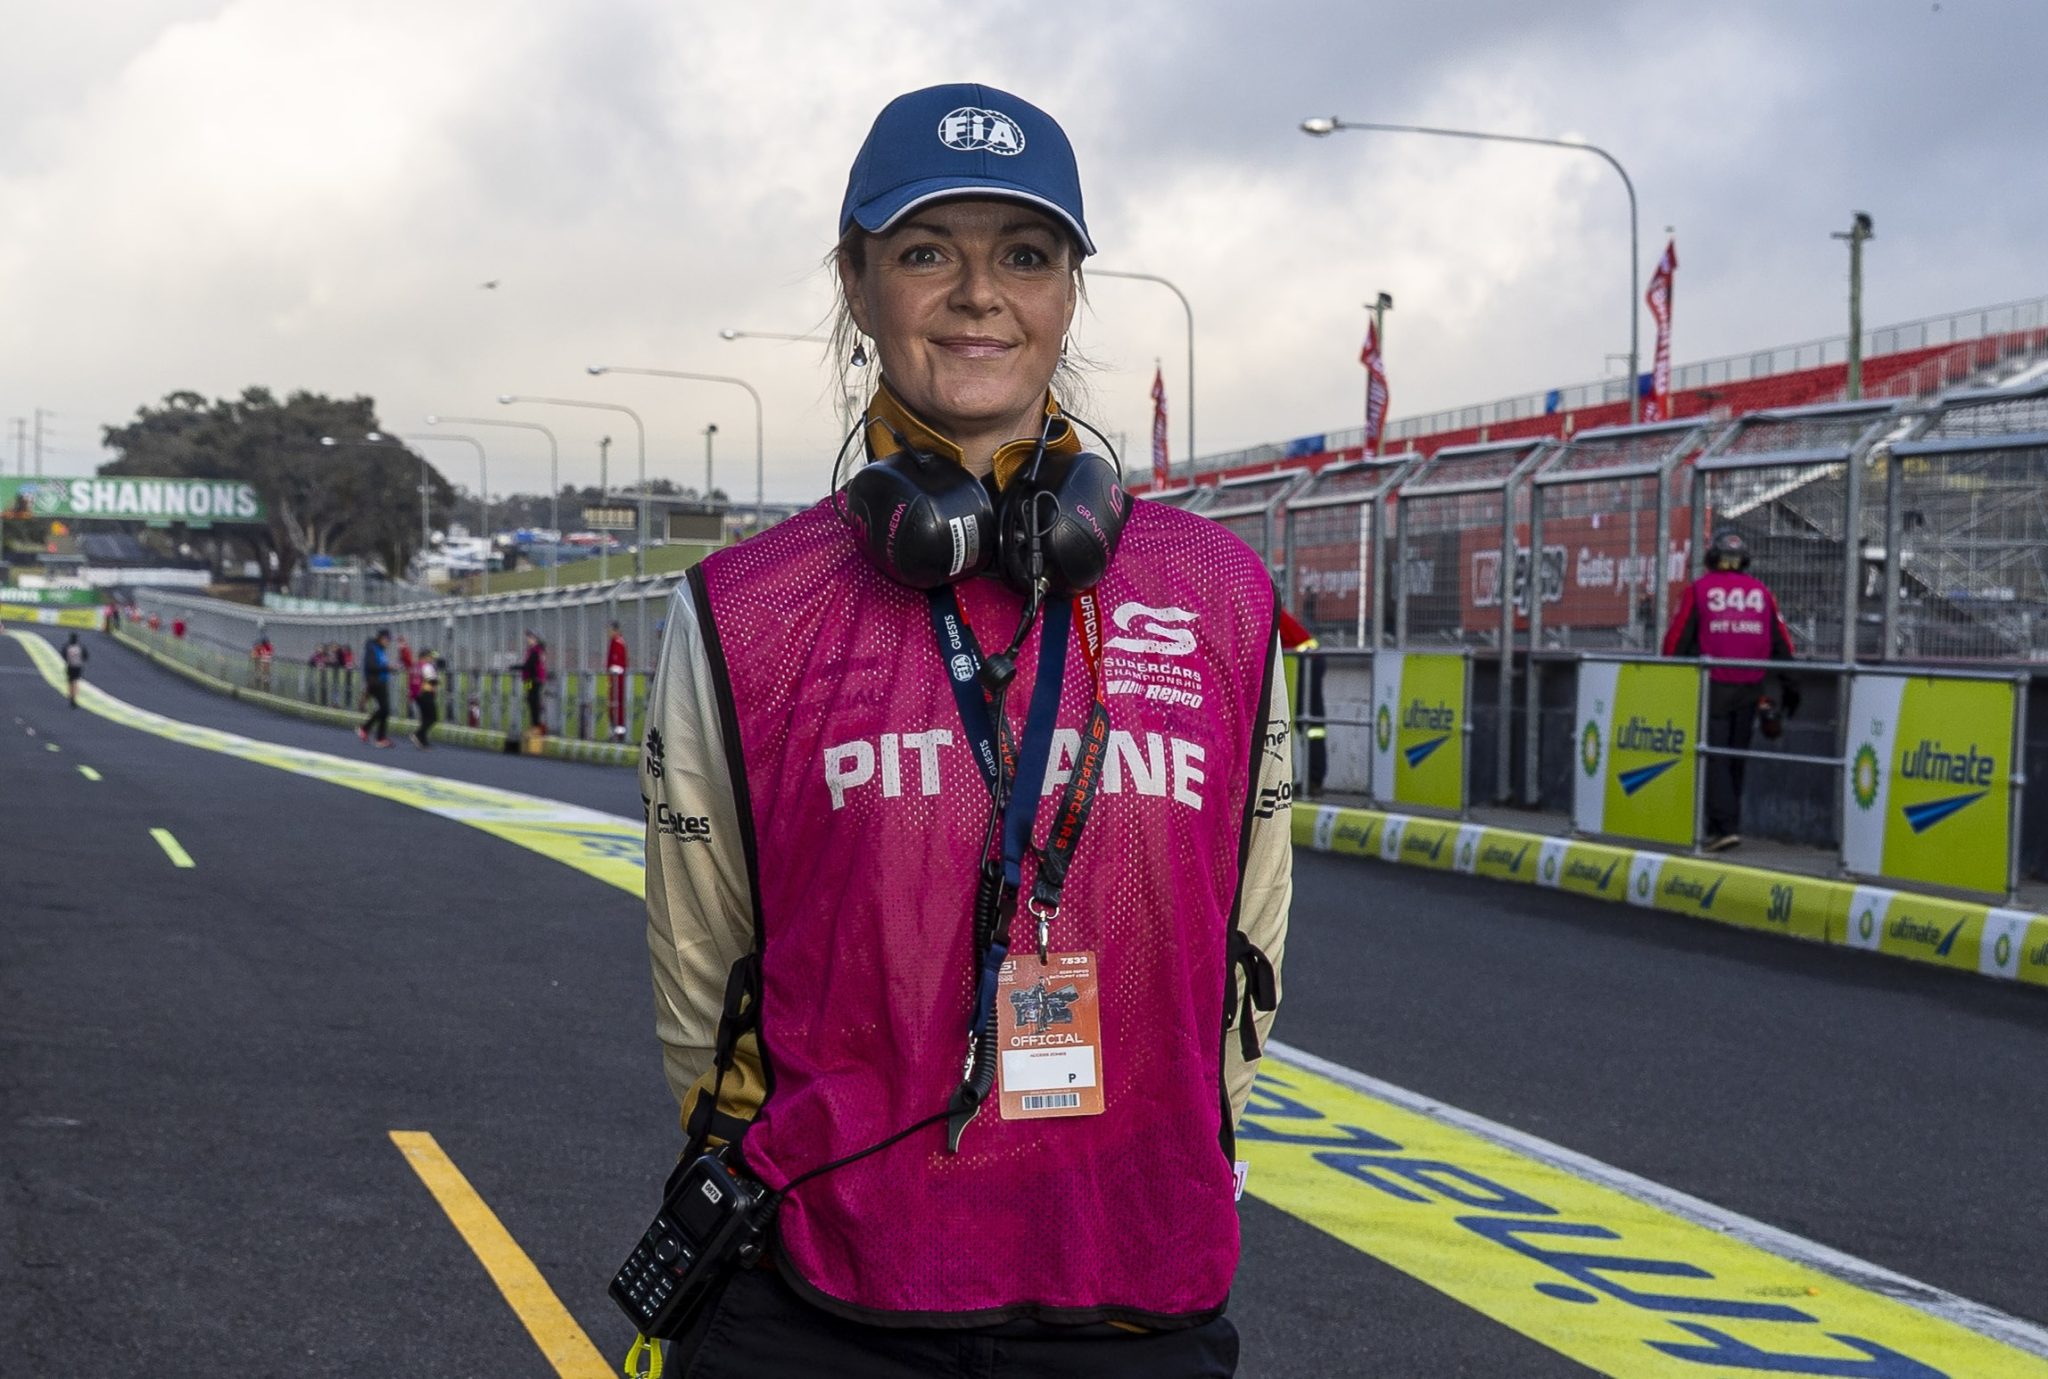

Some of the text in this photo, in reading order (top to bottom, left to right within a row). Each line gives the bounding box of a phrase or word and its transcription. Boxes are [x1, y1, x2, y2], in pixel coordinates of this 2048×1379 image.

[69, 480, 257, 518] SHANNONS
[1707, 587, 1764, 613] 344
[944, 614, 961, 649] GUESTS
[1080, 595, 1099, 658] OFFICIAL
[1103, 656, 1202, 683] SUPERCARS
[1403, 697, 1455, 731] ultimate
[1617, 717, 1685, 754] ultimate
[824, 728, 1205, 812] PIT ANE
[980, 739, 998, 777] GUESTS
[1901, 740, 1994, 787] ultimate
[1055, 742, 1101, 850] SUPERCARS
[1767, 884, 1793, 923] 30
[1889, 916, 1941, 946] ultimate
[1011, 1032, 1084, 1047] OFFICIAL
[1068, 1073, 1077, 1084] P
